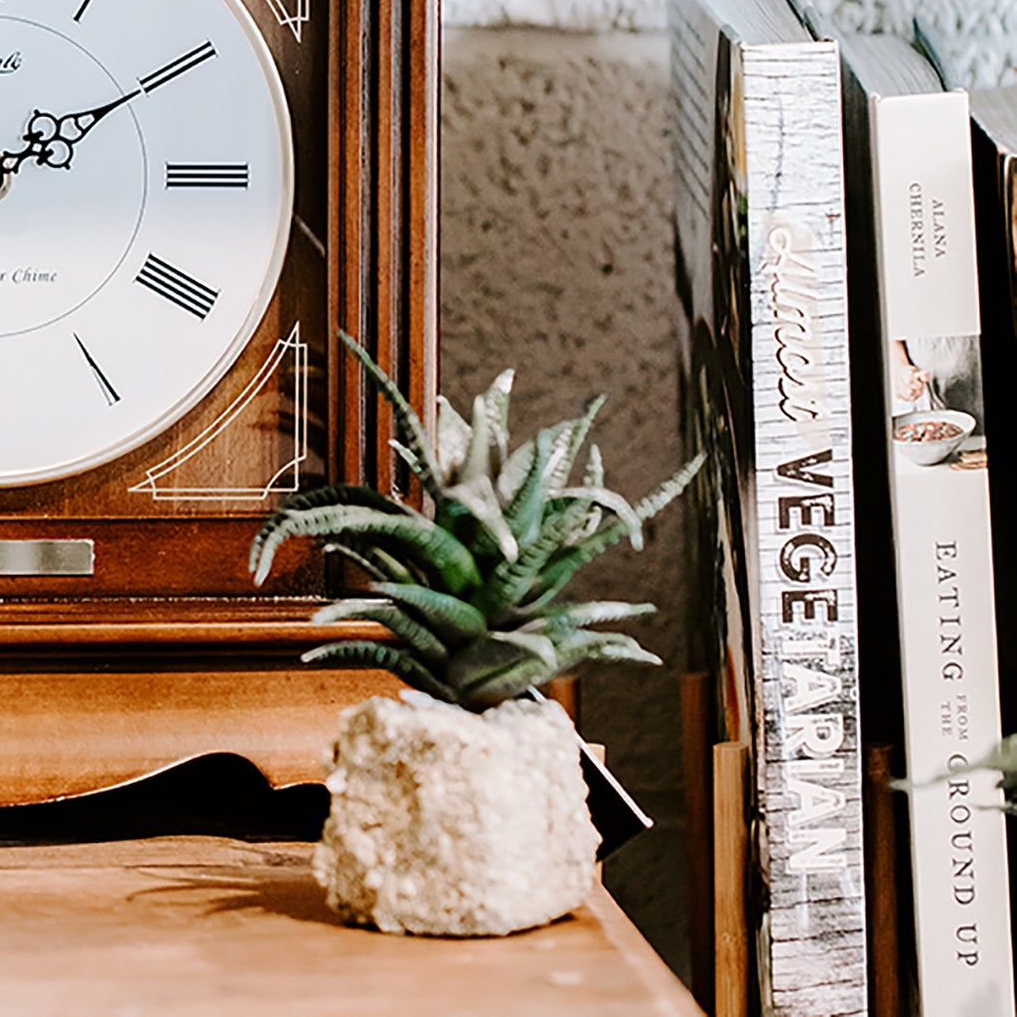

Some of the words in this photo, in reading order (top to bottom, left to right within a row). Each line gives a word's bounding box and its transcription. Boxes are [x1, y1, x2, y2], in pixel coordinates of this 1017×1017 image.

[909, 183, 925, 277] CHERNILA
[932, 199, 946, 258] ALANA
[12, 266, 58, 284] Chime
[935, 540, 964, 681] EATING
[776, 448, 848, 874] VEGETARIAN
[940, 700, 953, 737] THE
[956, 694, 969, 741] FROM
[955, 923, 979, 967] UP
